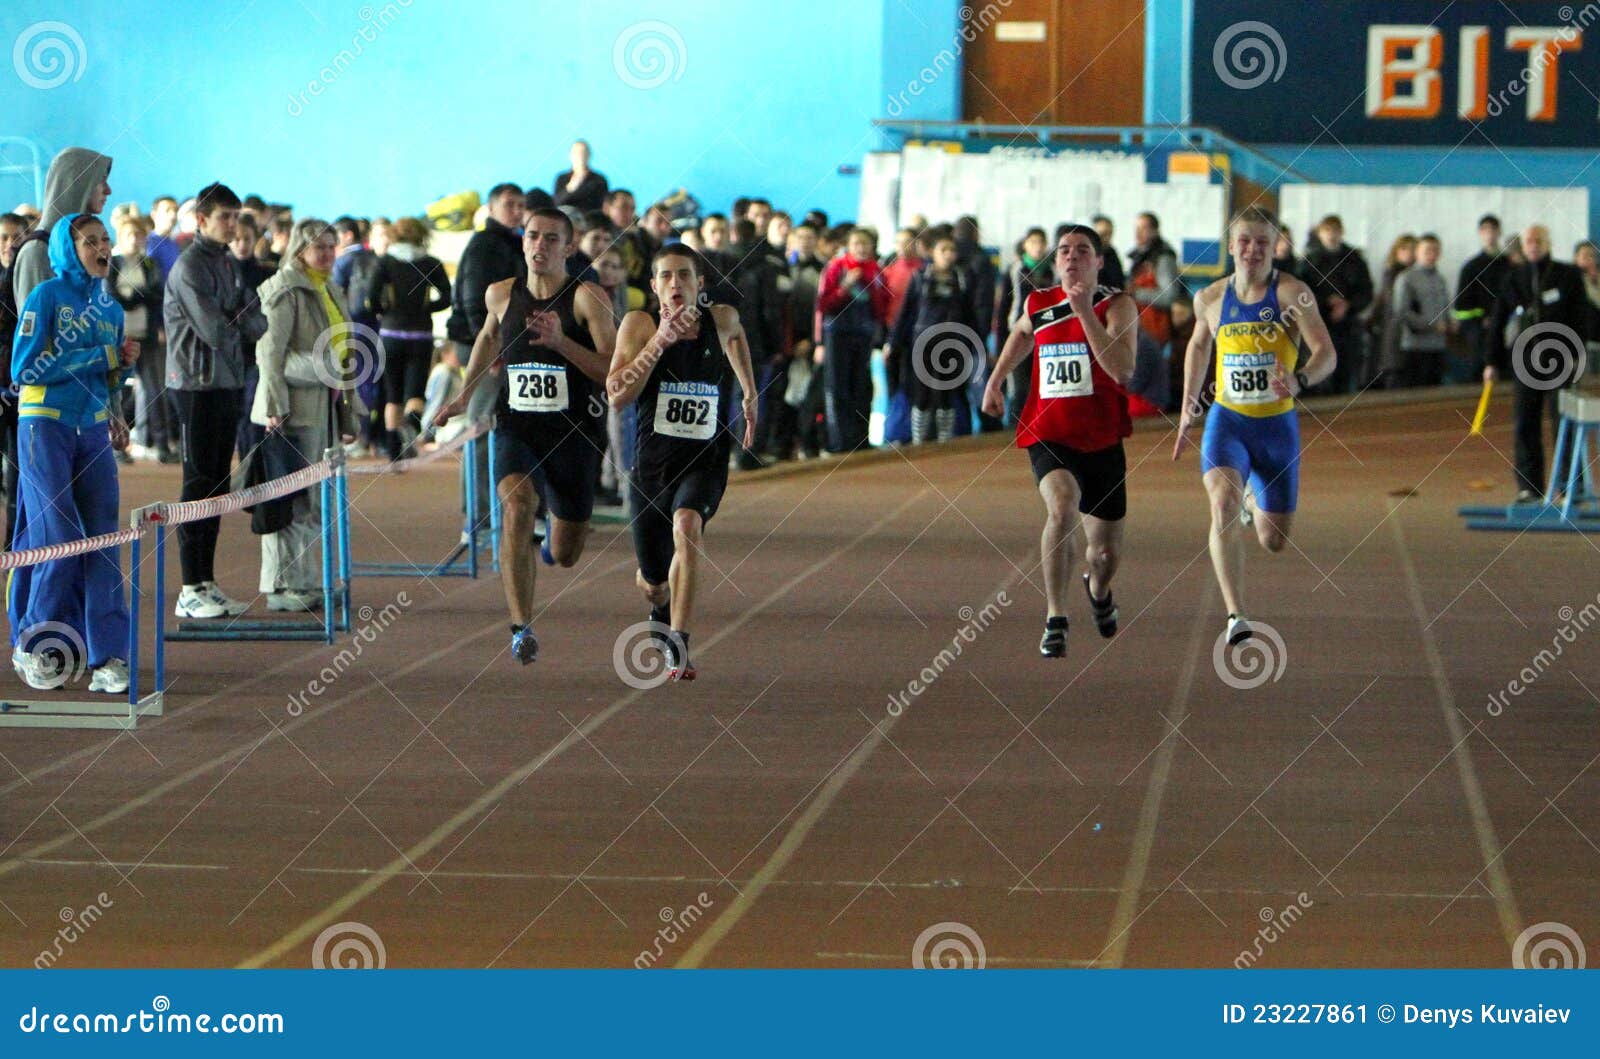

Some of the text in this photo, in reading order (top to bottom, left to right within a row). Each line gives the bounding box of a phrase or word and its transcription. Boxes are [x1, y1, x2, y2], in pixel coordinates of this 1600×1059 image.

[1046, 360, 1082, 385] 240
[1230, 369, 1269, 392] 638
[517, 374, 558, 399] 238
[659, 381, 719, 394] SAMSUNG
[665, 398, 710, 425] 862
